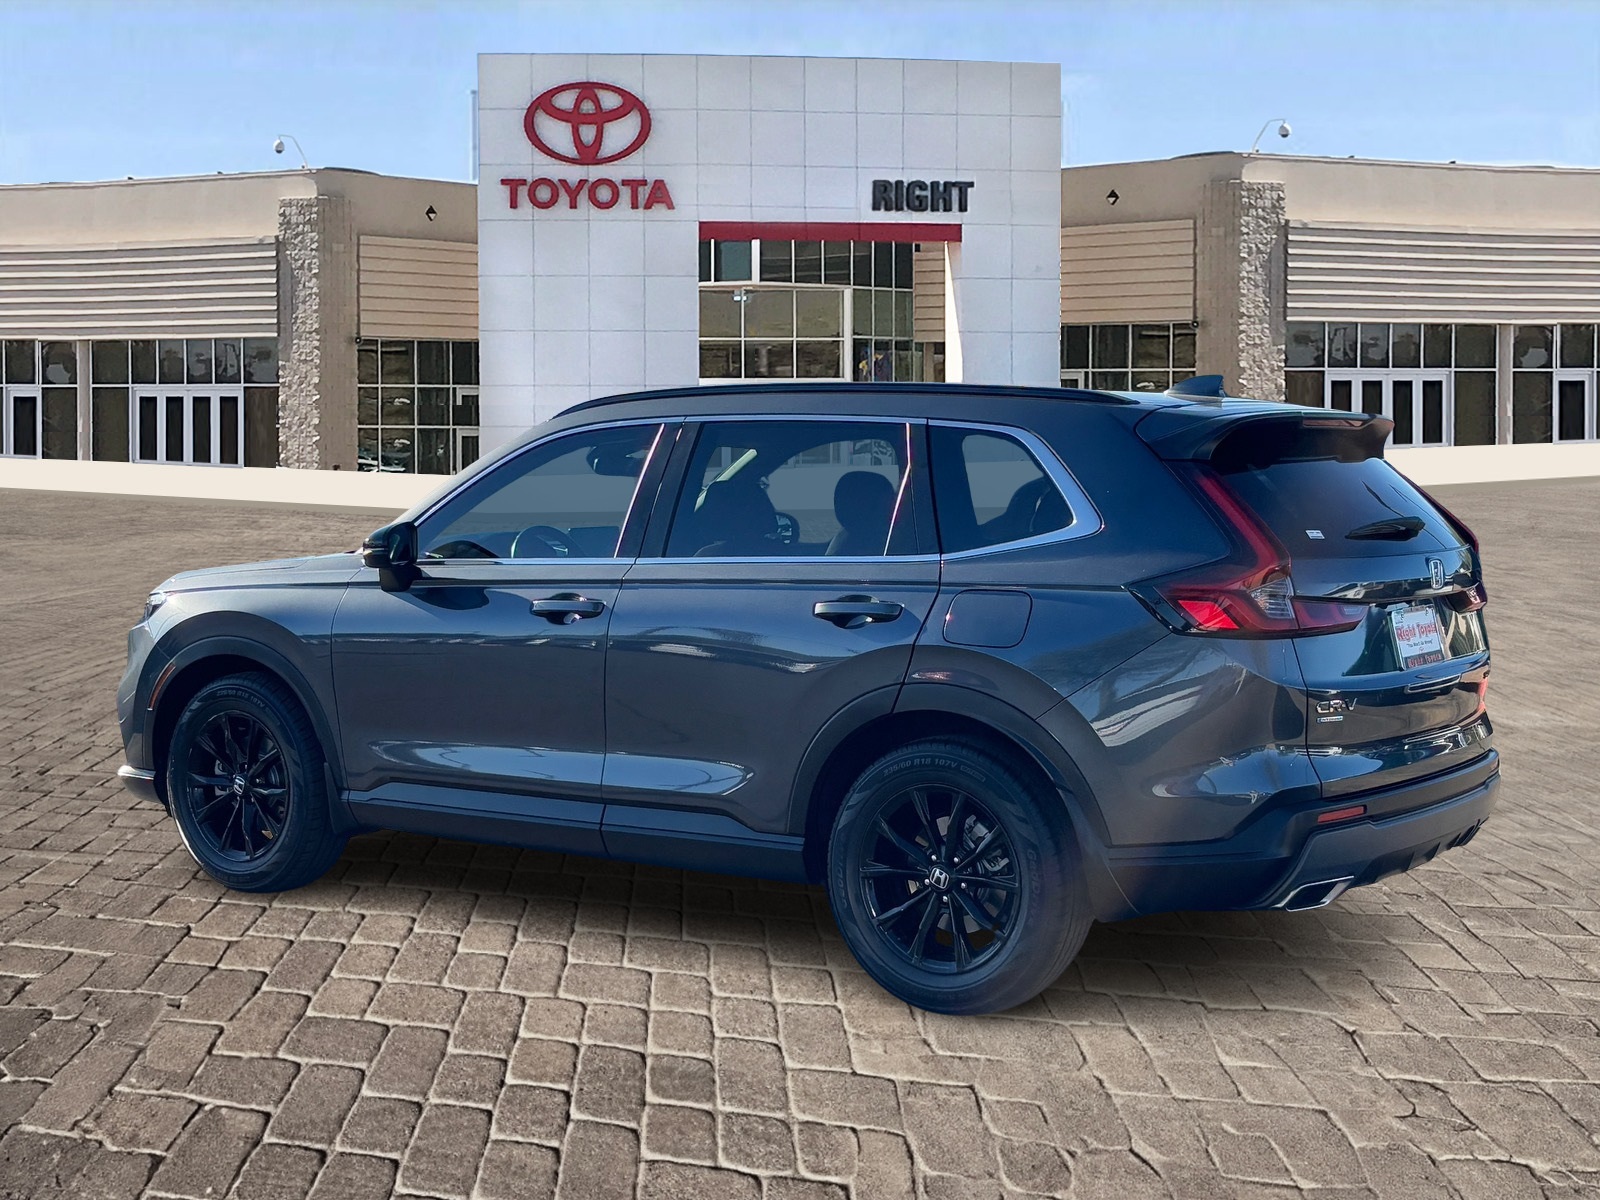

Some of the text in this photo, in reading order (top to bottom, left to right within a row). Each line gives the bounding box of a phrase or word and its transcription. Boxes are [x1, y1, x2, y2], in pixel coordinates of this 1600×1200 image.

[500, 177, 676, 210] TOYOTA
[871, 179, 975, 212] RIGHT
[883, 758, 958, 777] 235/60 R18 107V
